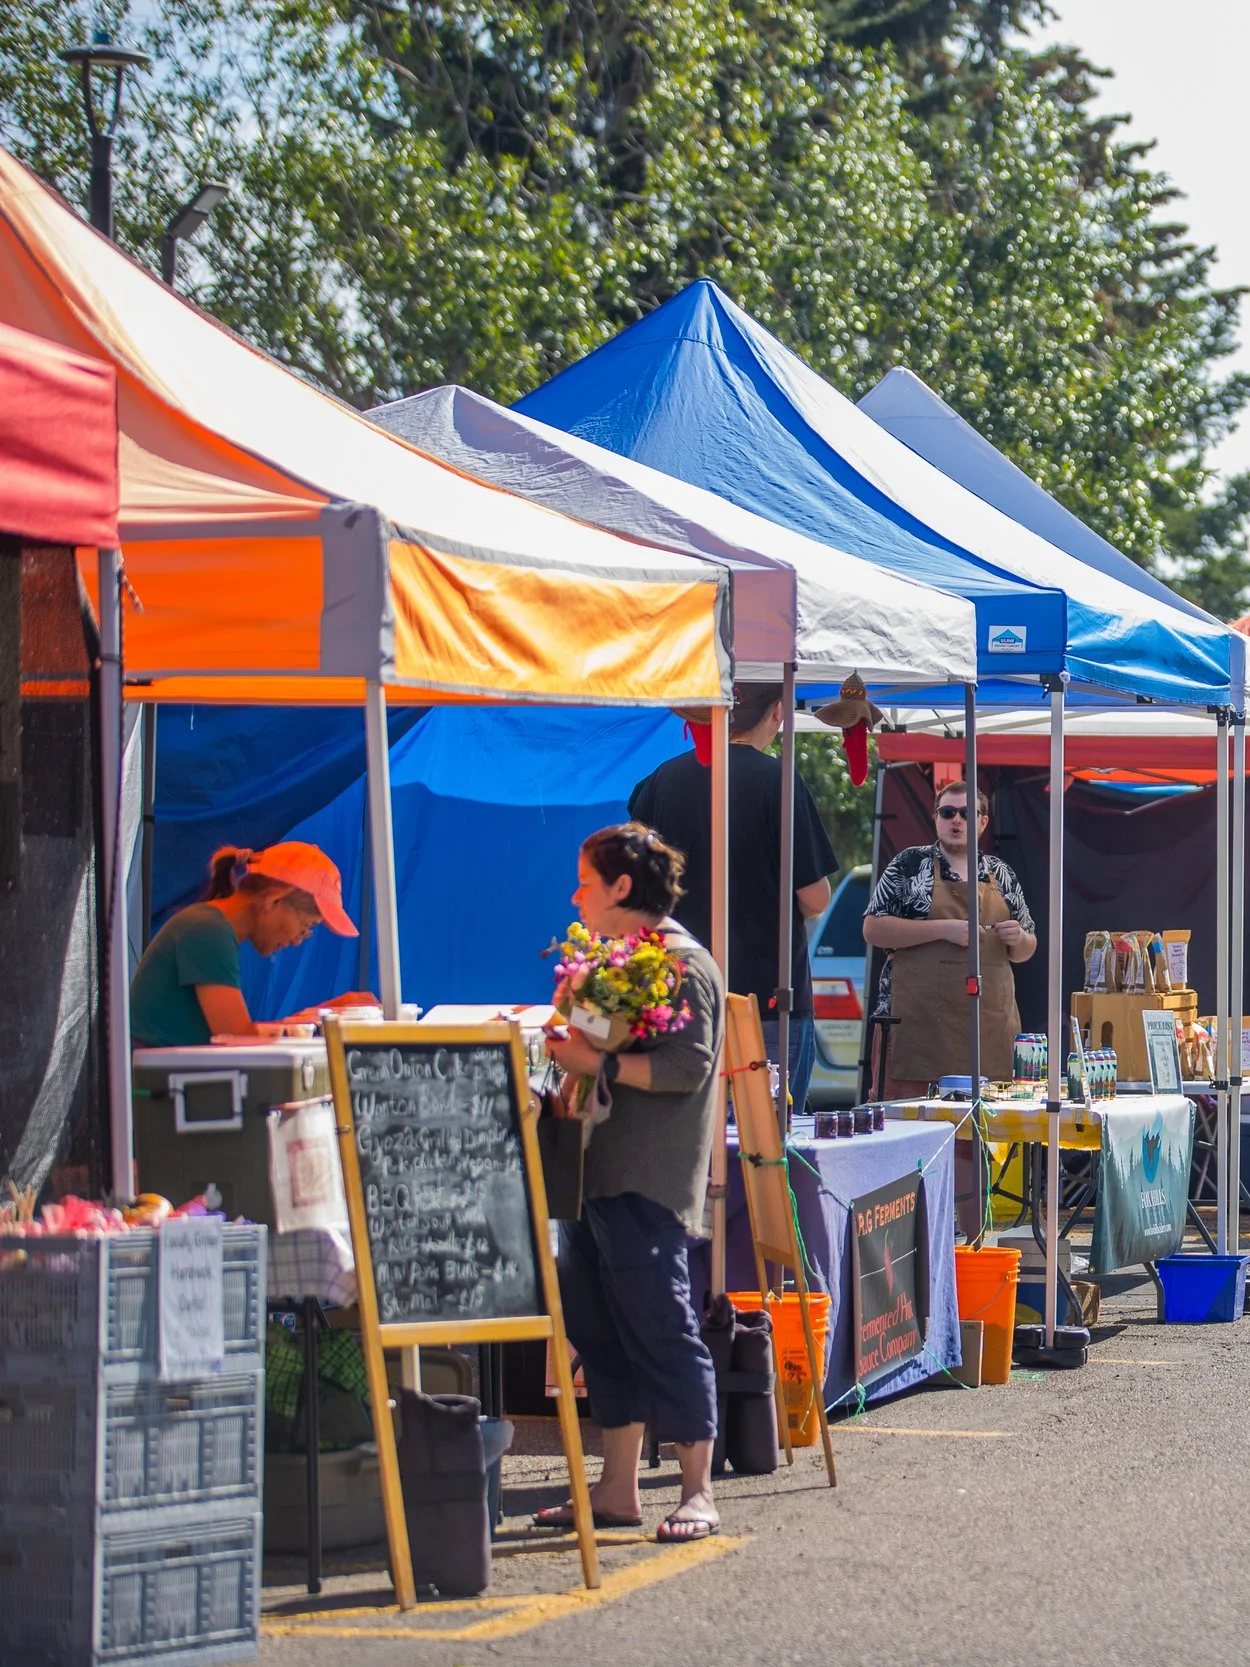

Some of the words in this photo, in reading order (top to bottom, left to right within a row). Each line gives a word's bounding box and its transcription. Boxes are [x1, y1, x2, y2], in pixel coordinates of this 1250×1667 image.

[1147, 1021, 1162, 1030] PRICE
[1162, 1021, 1173, 1031] LIST
[390, 1048, 432, 1081] Onion
[367, 1183, 412, 1215] BBQ
[874, 1191, 916, 1229] FERMENTS
[1151, 1188, 1166, 1207] HILLS
[861, 1295, 900, 1342] ermented
[900, 1291, 914, 1324] Hot
[879, 1330, 916, 1362] Company
